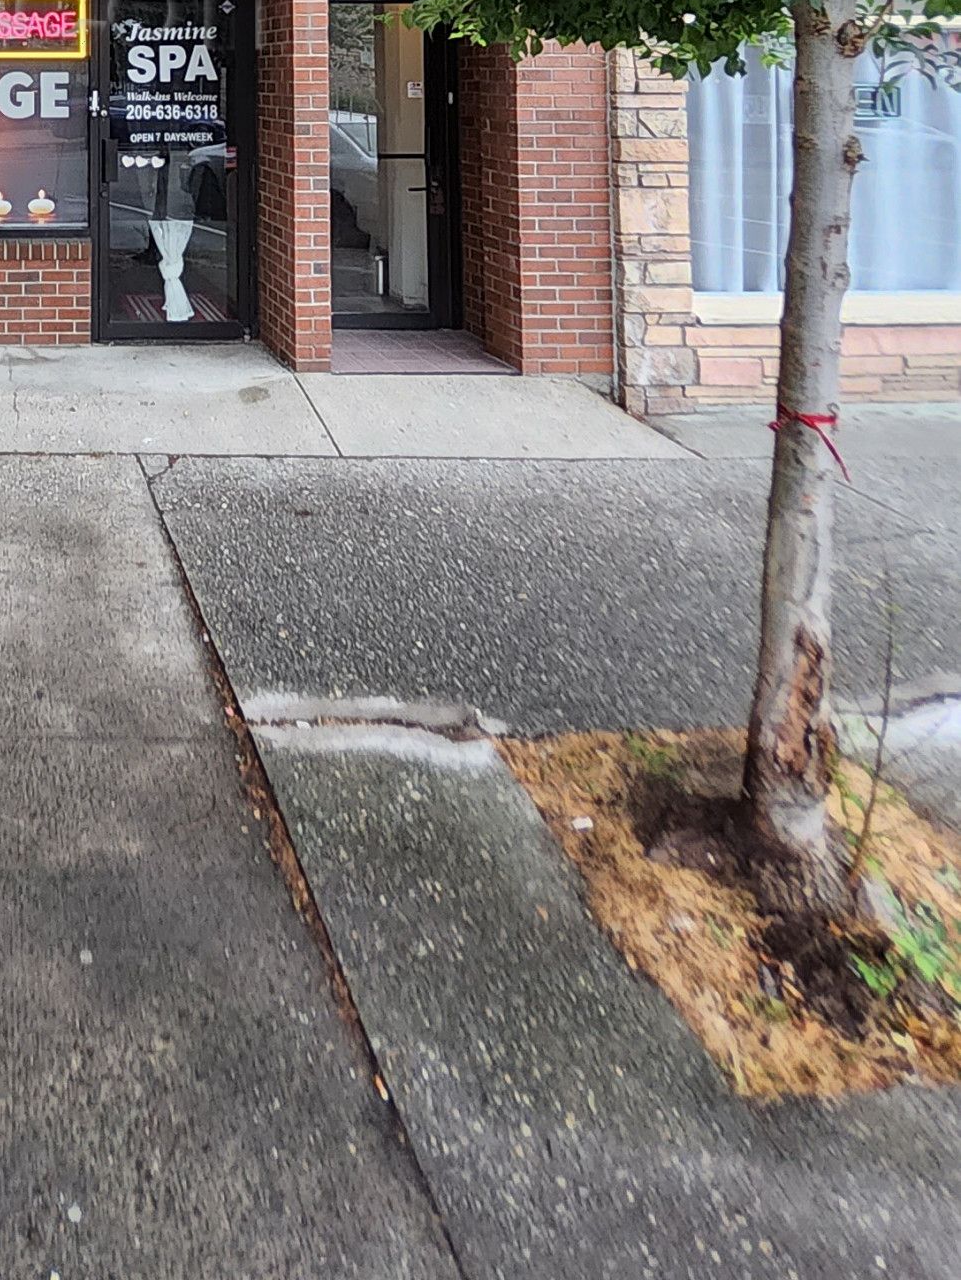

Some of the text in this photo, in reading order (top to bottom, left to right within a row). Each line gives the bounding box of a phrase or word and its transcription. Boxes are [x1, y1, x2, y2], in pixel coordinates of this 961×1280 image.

[125, 20, 218, 42] Jasmine
[127, 44, 219, 84] SPA
[173, 91, 219, 102] Welcome
[125, 104, 219, 121] 206-636-6318
[129, 132, 155, 144] OPEN
[155, 131, 162, 143] 7
